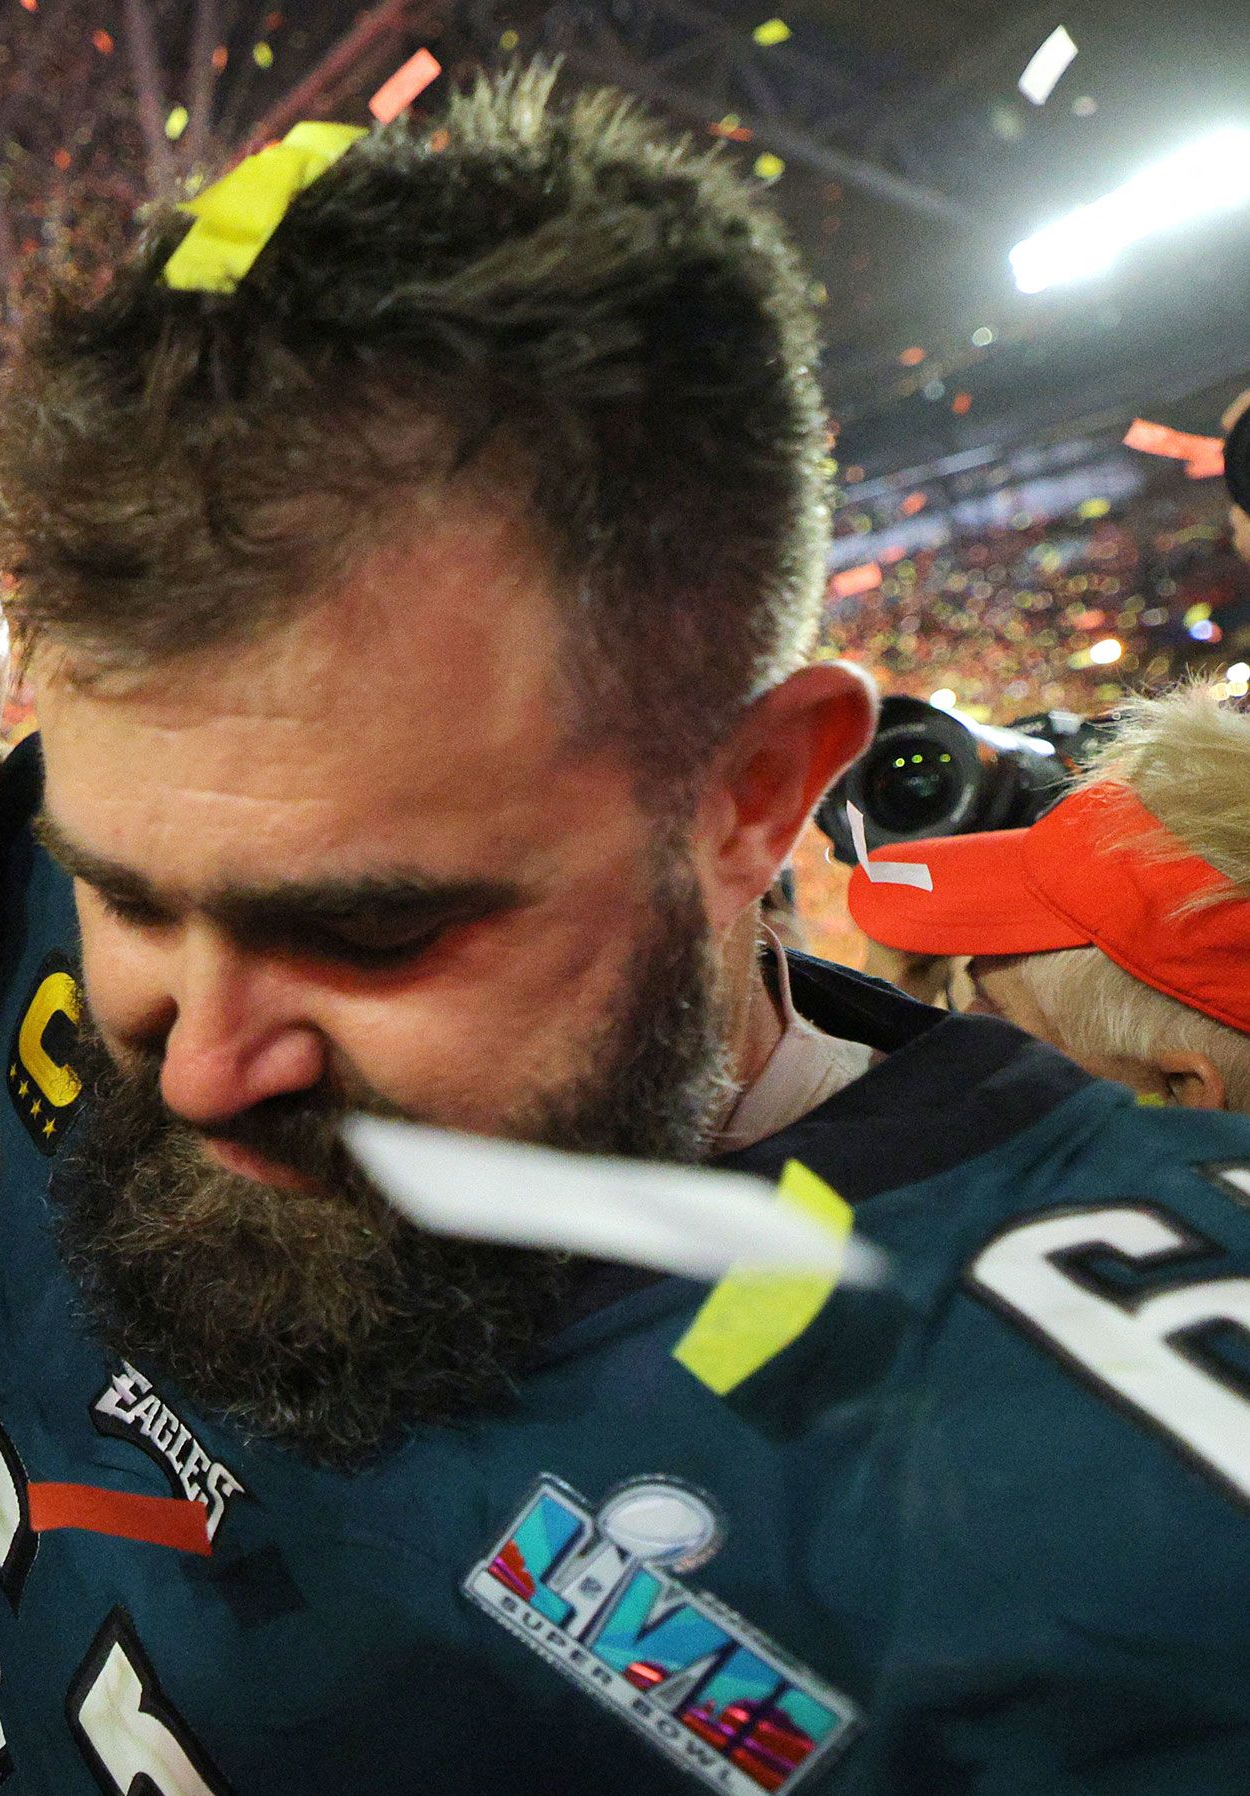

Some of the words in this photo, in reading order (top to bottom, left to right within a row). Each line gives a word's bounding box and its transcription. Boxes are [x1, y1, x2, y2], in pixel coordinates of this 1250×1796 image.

[18, 971, 83, 1108] C
[94, 1360, 247, 1544] EAGLES
[487, 1493, 844, 1793] LVII
[502, 1594, 614, 1685] SUPER
[631, 1696, 737, 1785] BOWL
